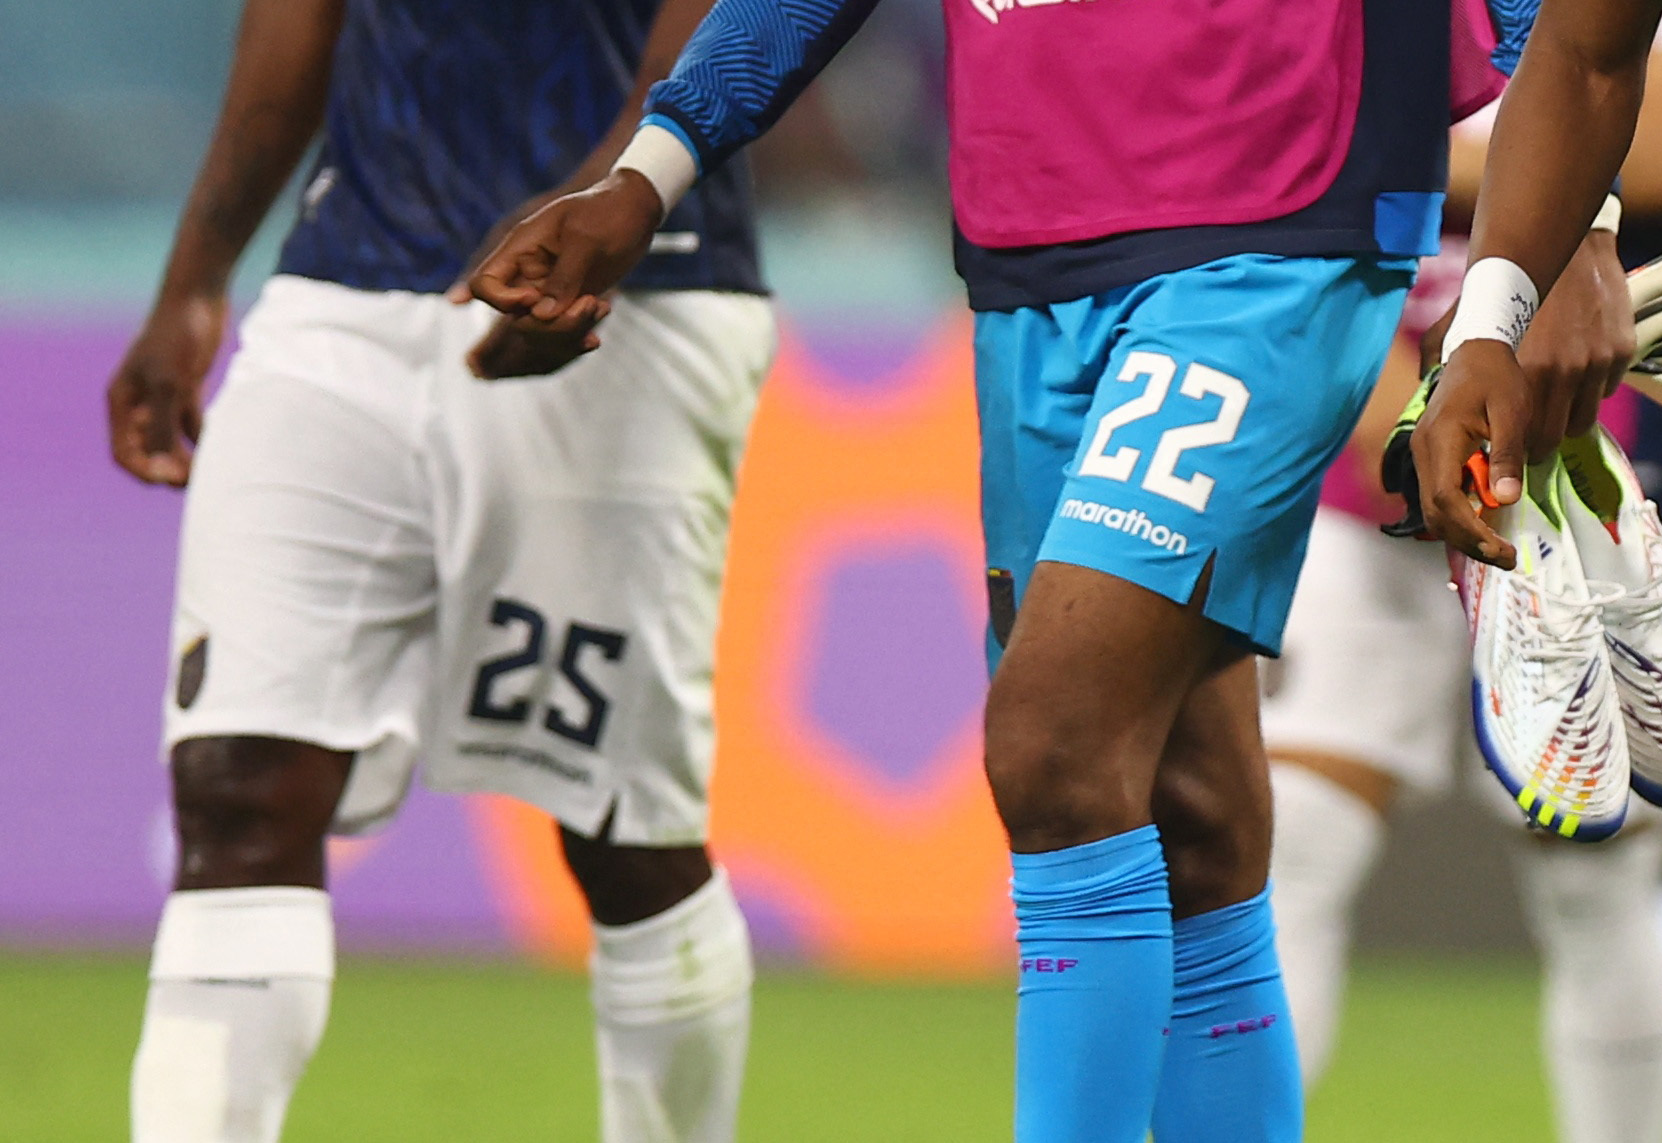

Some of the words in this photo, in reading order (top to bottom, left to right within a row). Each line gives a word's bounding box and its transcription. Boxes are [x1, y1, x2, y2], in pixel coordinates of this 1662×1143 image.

[1078, 350, 1250, 514] 22
[1059, 498, 1189, 556] marathon
[469, 598, 627, 748] 25
